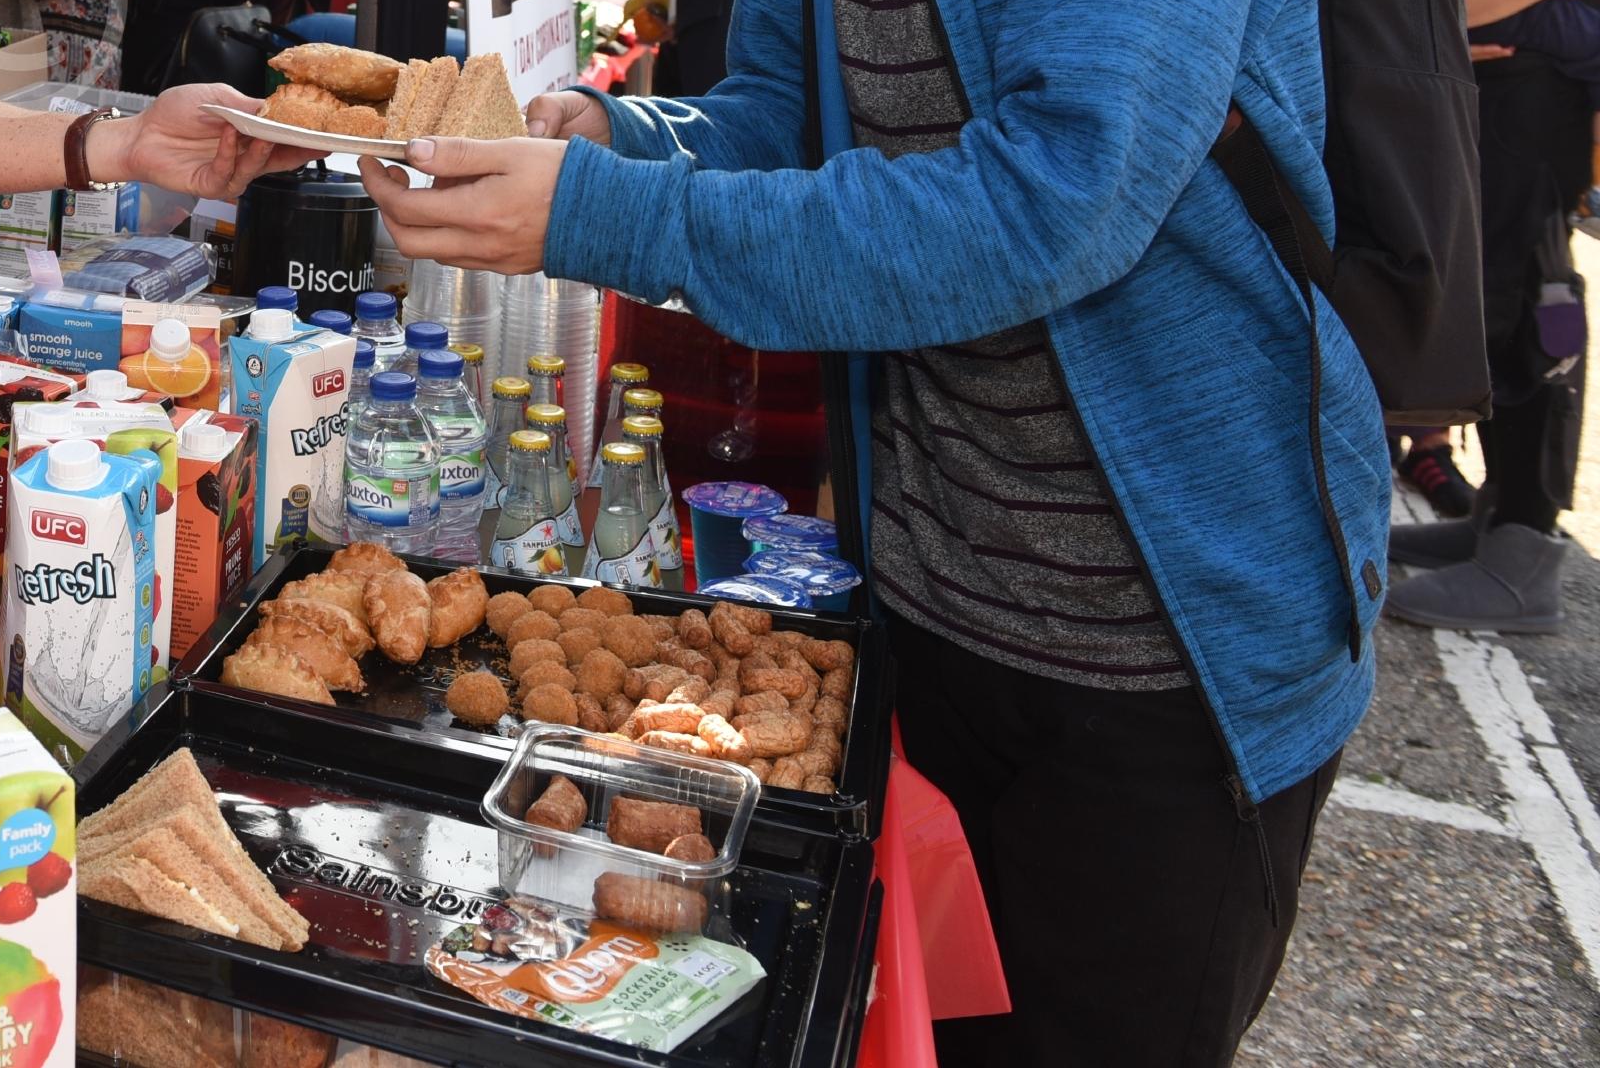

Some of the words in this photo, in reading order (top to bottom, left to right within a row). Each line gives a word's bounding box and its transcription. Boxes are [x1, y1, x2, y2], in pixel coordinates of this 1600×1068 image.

[288, 261, 375, 292] Biscuits
[64, 318, 93, 329] smooth
[30, 332, 72, 346] smooth
[30, 345, 71, 359] orange
[74, 347, 103, 361] juice
[46, 357, 86, 368] concentrate
[315, 374, 344, 393] UFC
[36, 515, 82, 539] UFC
[225, 548, 242, 576] PRUNE
[2, 822, 52, 842] Family
[10, 839, 42, 860] pack
[544, 933, 645, 997] Quorn
[693, 970, 704, 979] 14
[702, 962, 719, 973] OCT
[612, 964, 666, 1006] COCKTAIL
[623, 970, 679, 1012] SAUSAGES
